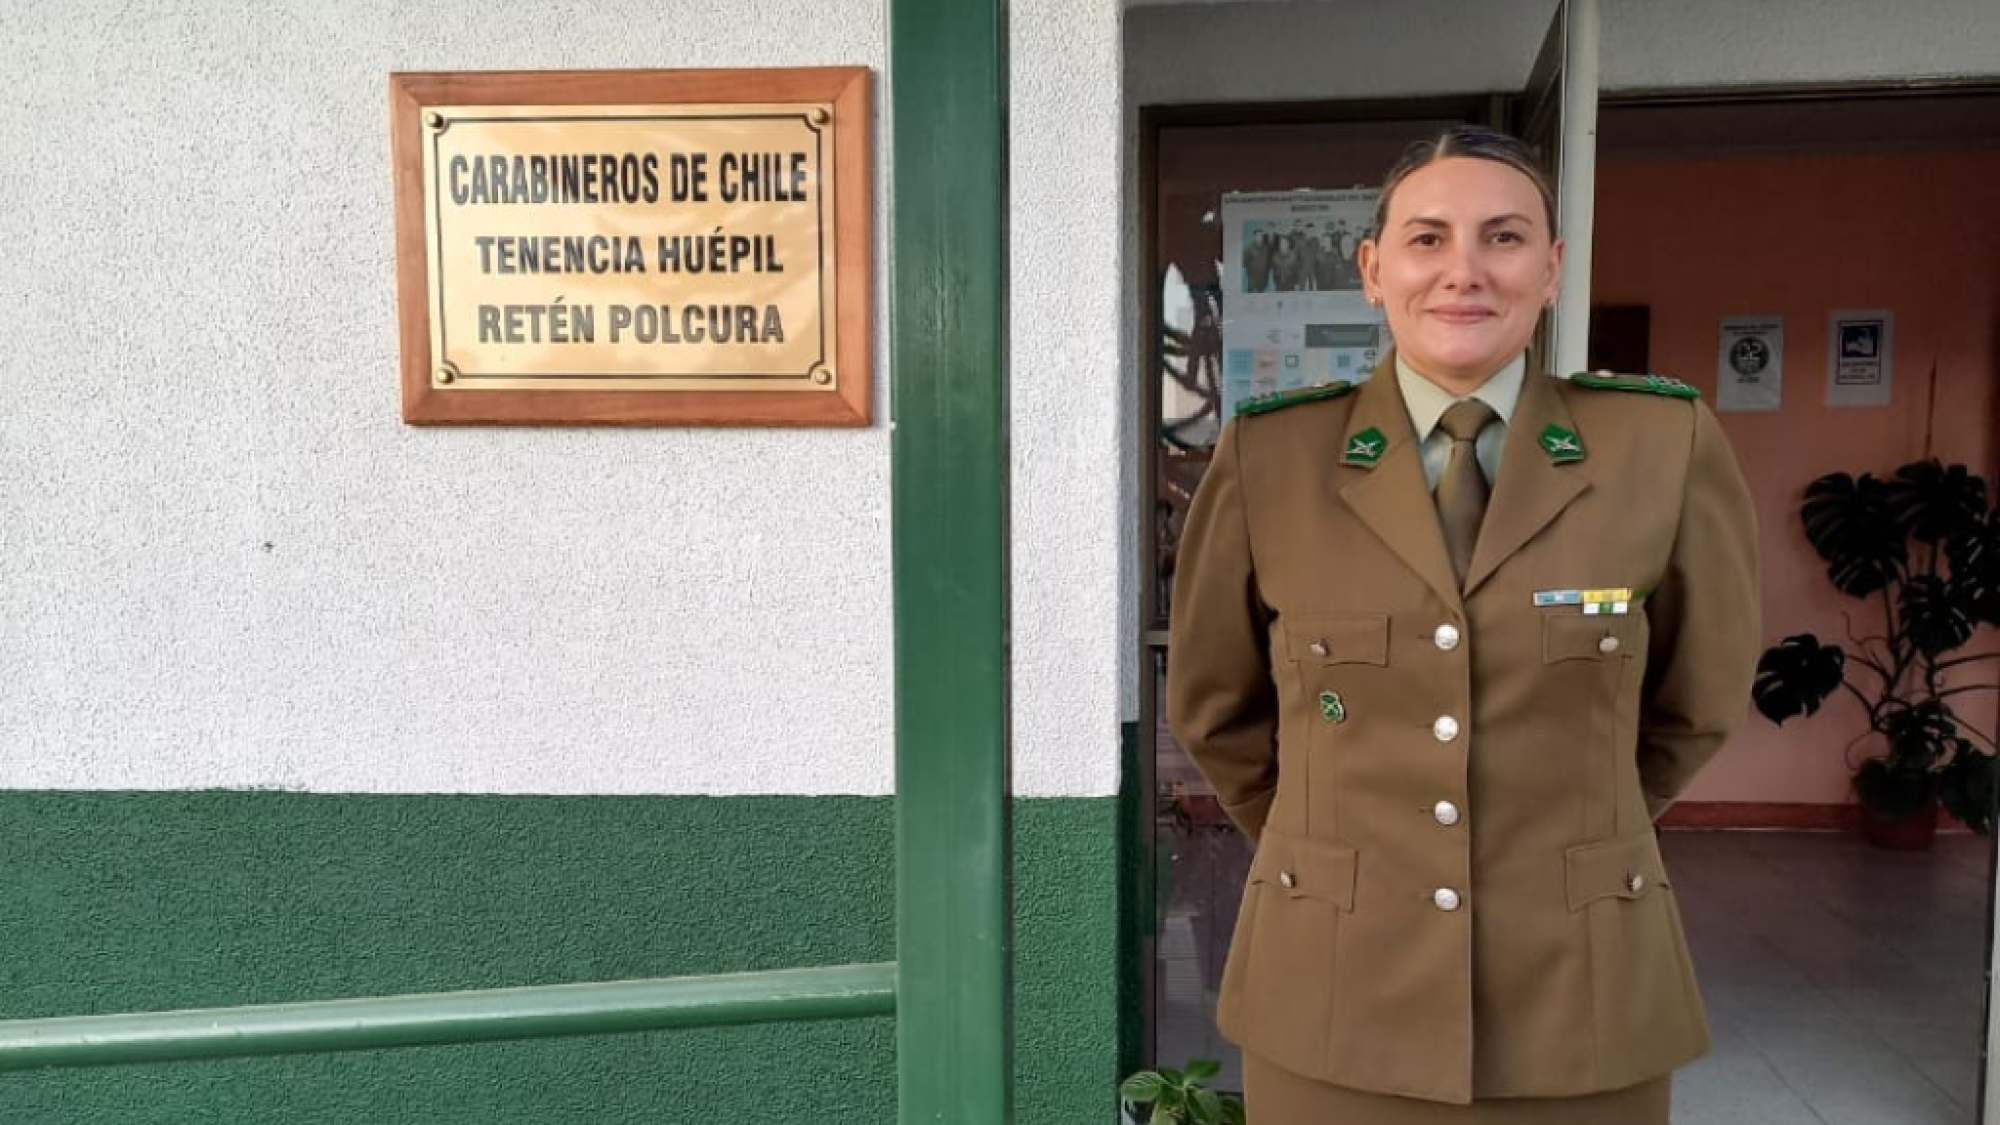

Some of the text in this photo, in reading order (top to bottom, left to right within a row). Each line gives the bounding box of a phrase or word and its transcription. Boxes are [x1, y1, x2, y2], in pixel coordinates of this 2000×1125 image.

[450, 152, 807, 205] CARABINEROS DE CHILE
[474, 227, 784, 274] TENENCIA HUÉPIL
[477, 296, 785, 343] RETÉN POLCURA
